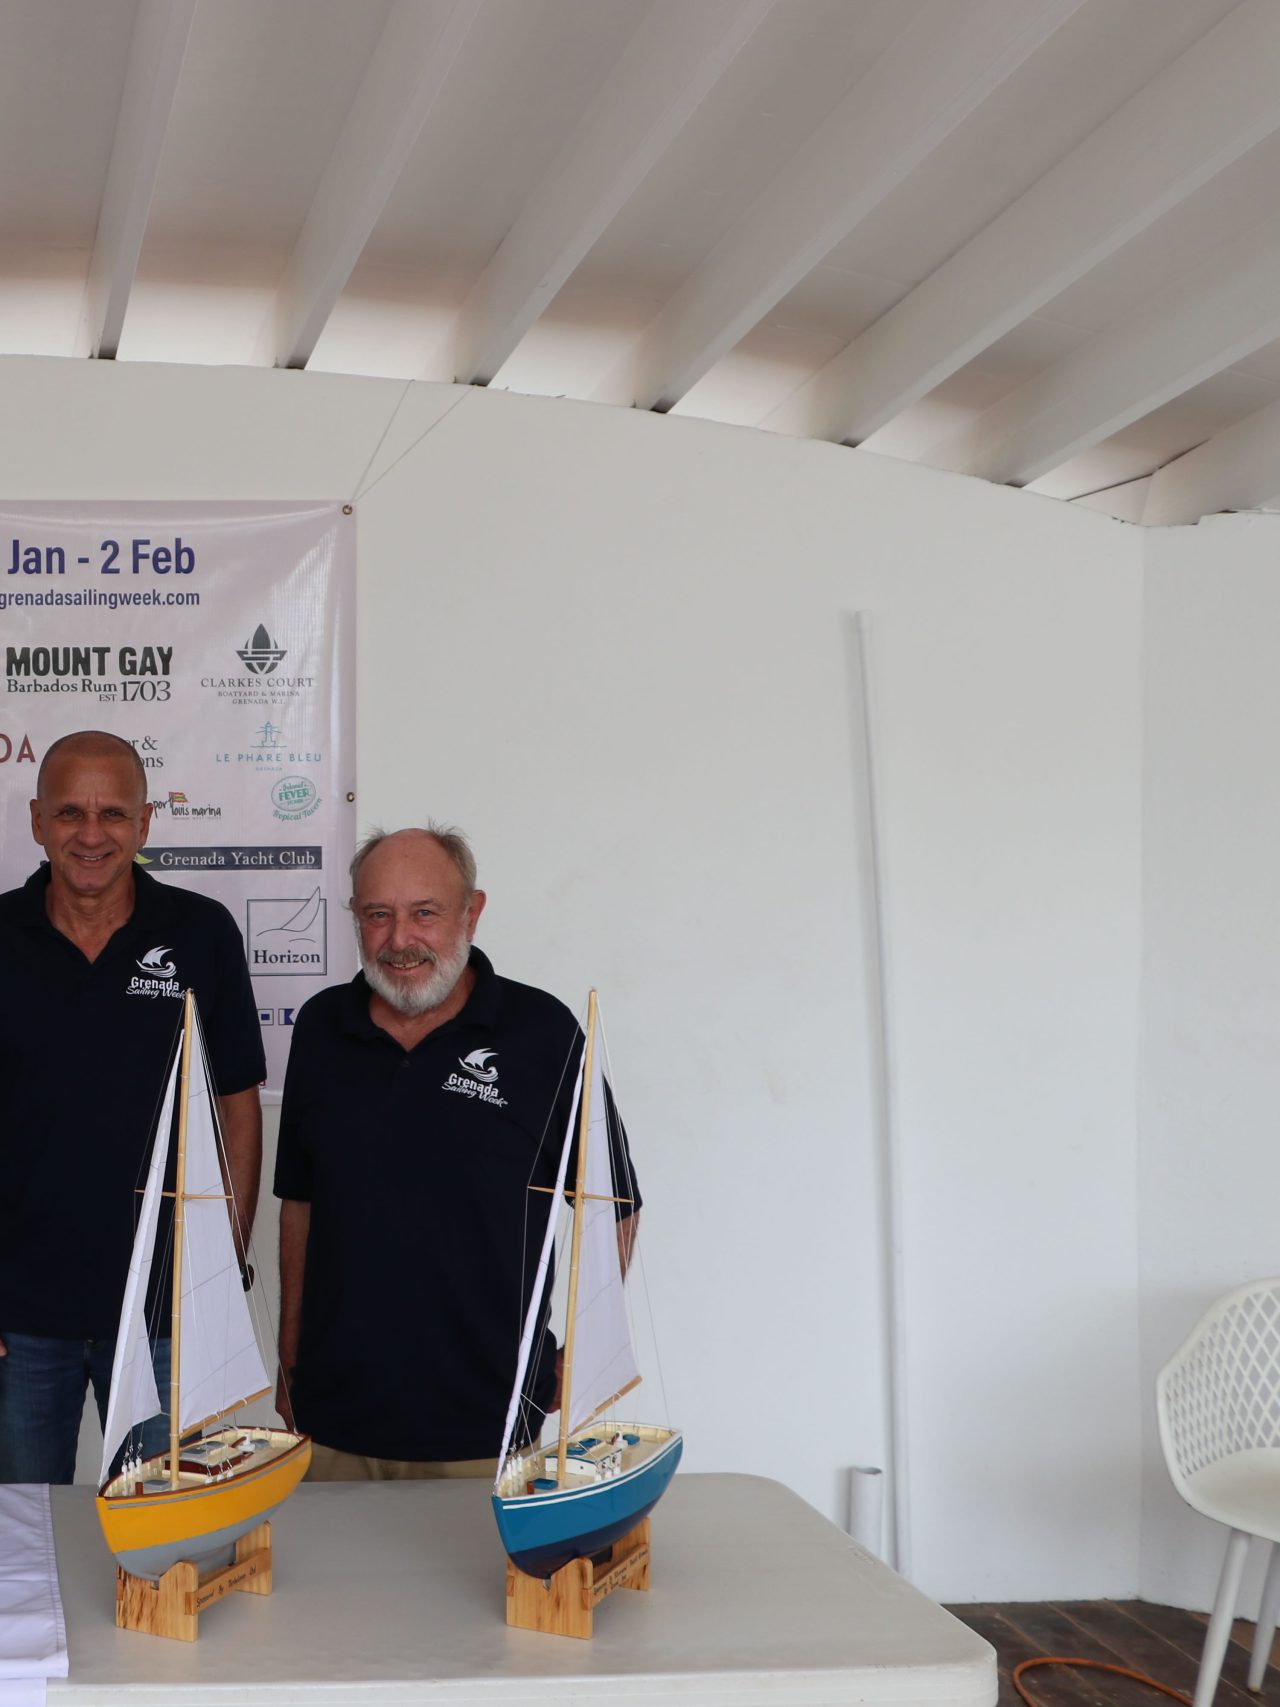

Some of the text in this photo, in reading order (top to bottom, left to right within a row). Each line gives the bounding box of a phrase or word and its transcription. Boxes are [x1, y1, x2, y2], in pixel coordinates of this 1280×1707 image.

[8, 539, 66, 575] Jan
[99, 539, 121, 574] 2
[132, 537, 196, 574] Feb
[6, 646, 173, 677] MOUNT GAY
[6, 678, 118, 694] Barbados Rum
[200, 677, 315, 689] CLARKES COURT
[98, 680, 172, 703] EST 1703
[217, 690, 259, 698] BOATYARD
[216, 753, 322, 763] LE PHARE BLEU
[278, 787, 310, 802] FEVER
[191, 804, 222, 817] marina
[160, 851, 316, 866] Grenada Yacht Club
[253, 949, 321, 964] Horizon
[130, 976, 180, 991] Grenada
[125, 986, 160, 998] Sailing
[441, 1082, 477, 1098] Sailing
[448, 1073, 499, 1097] Grenada
